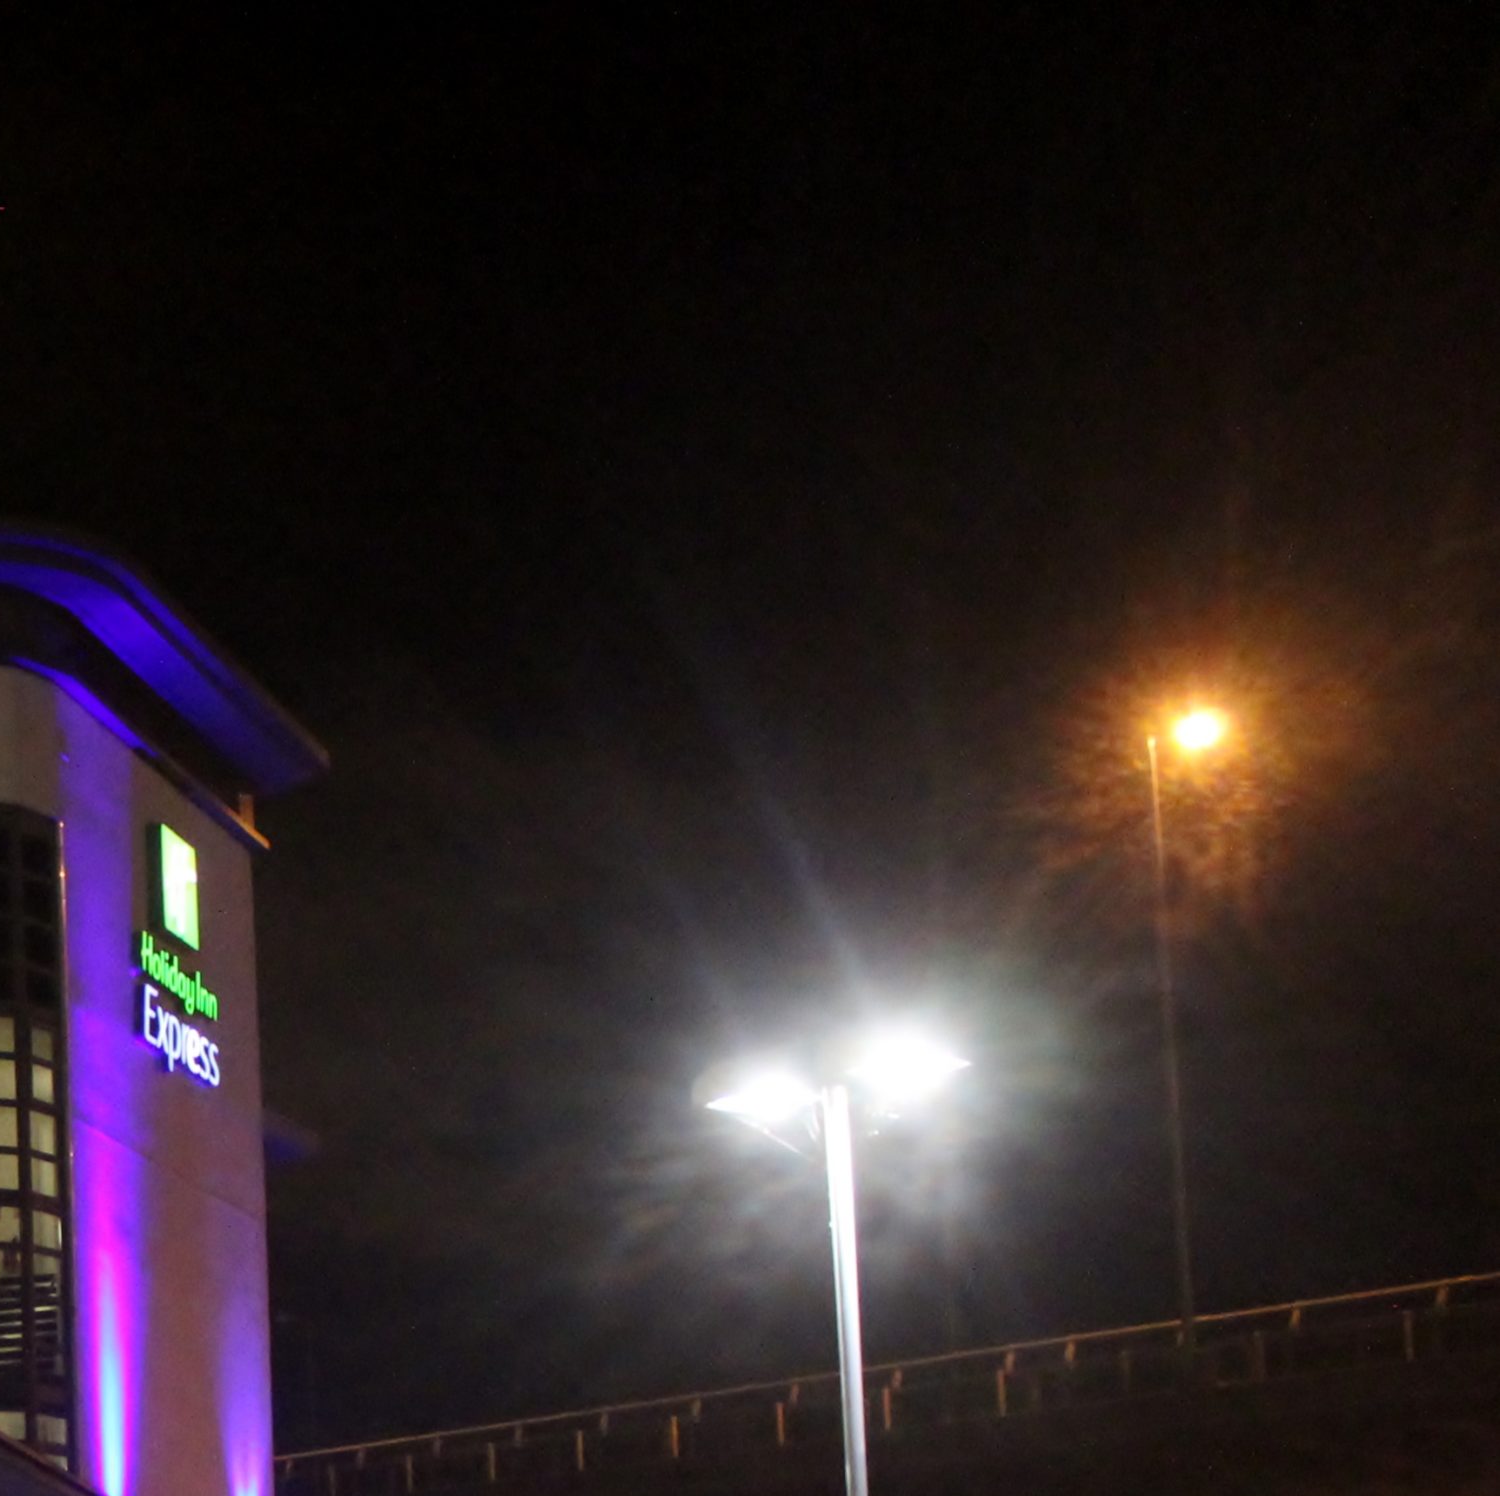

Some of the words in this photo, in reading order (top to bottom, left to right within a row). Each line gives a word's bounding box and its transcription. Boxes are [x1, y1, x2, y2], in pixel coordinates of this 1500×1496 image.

[141, 930, 194, 1015] Holiday
[195, 971, 218, 1021] Inn
[143, 983, 220, 1087] Express
